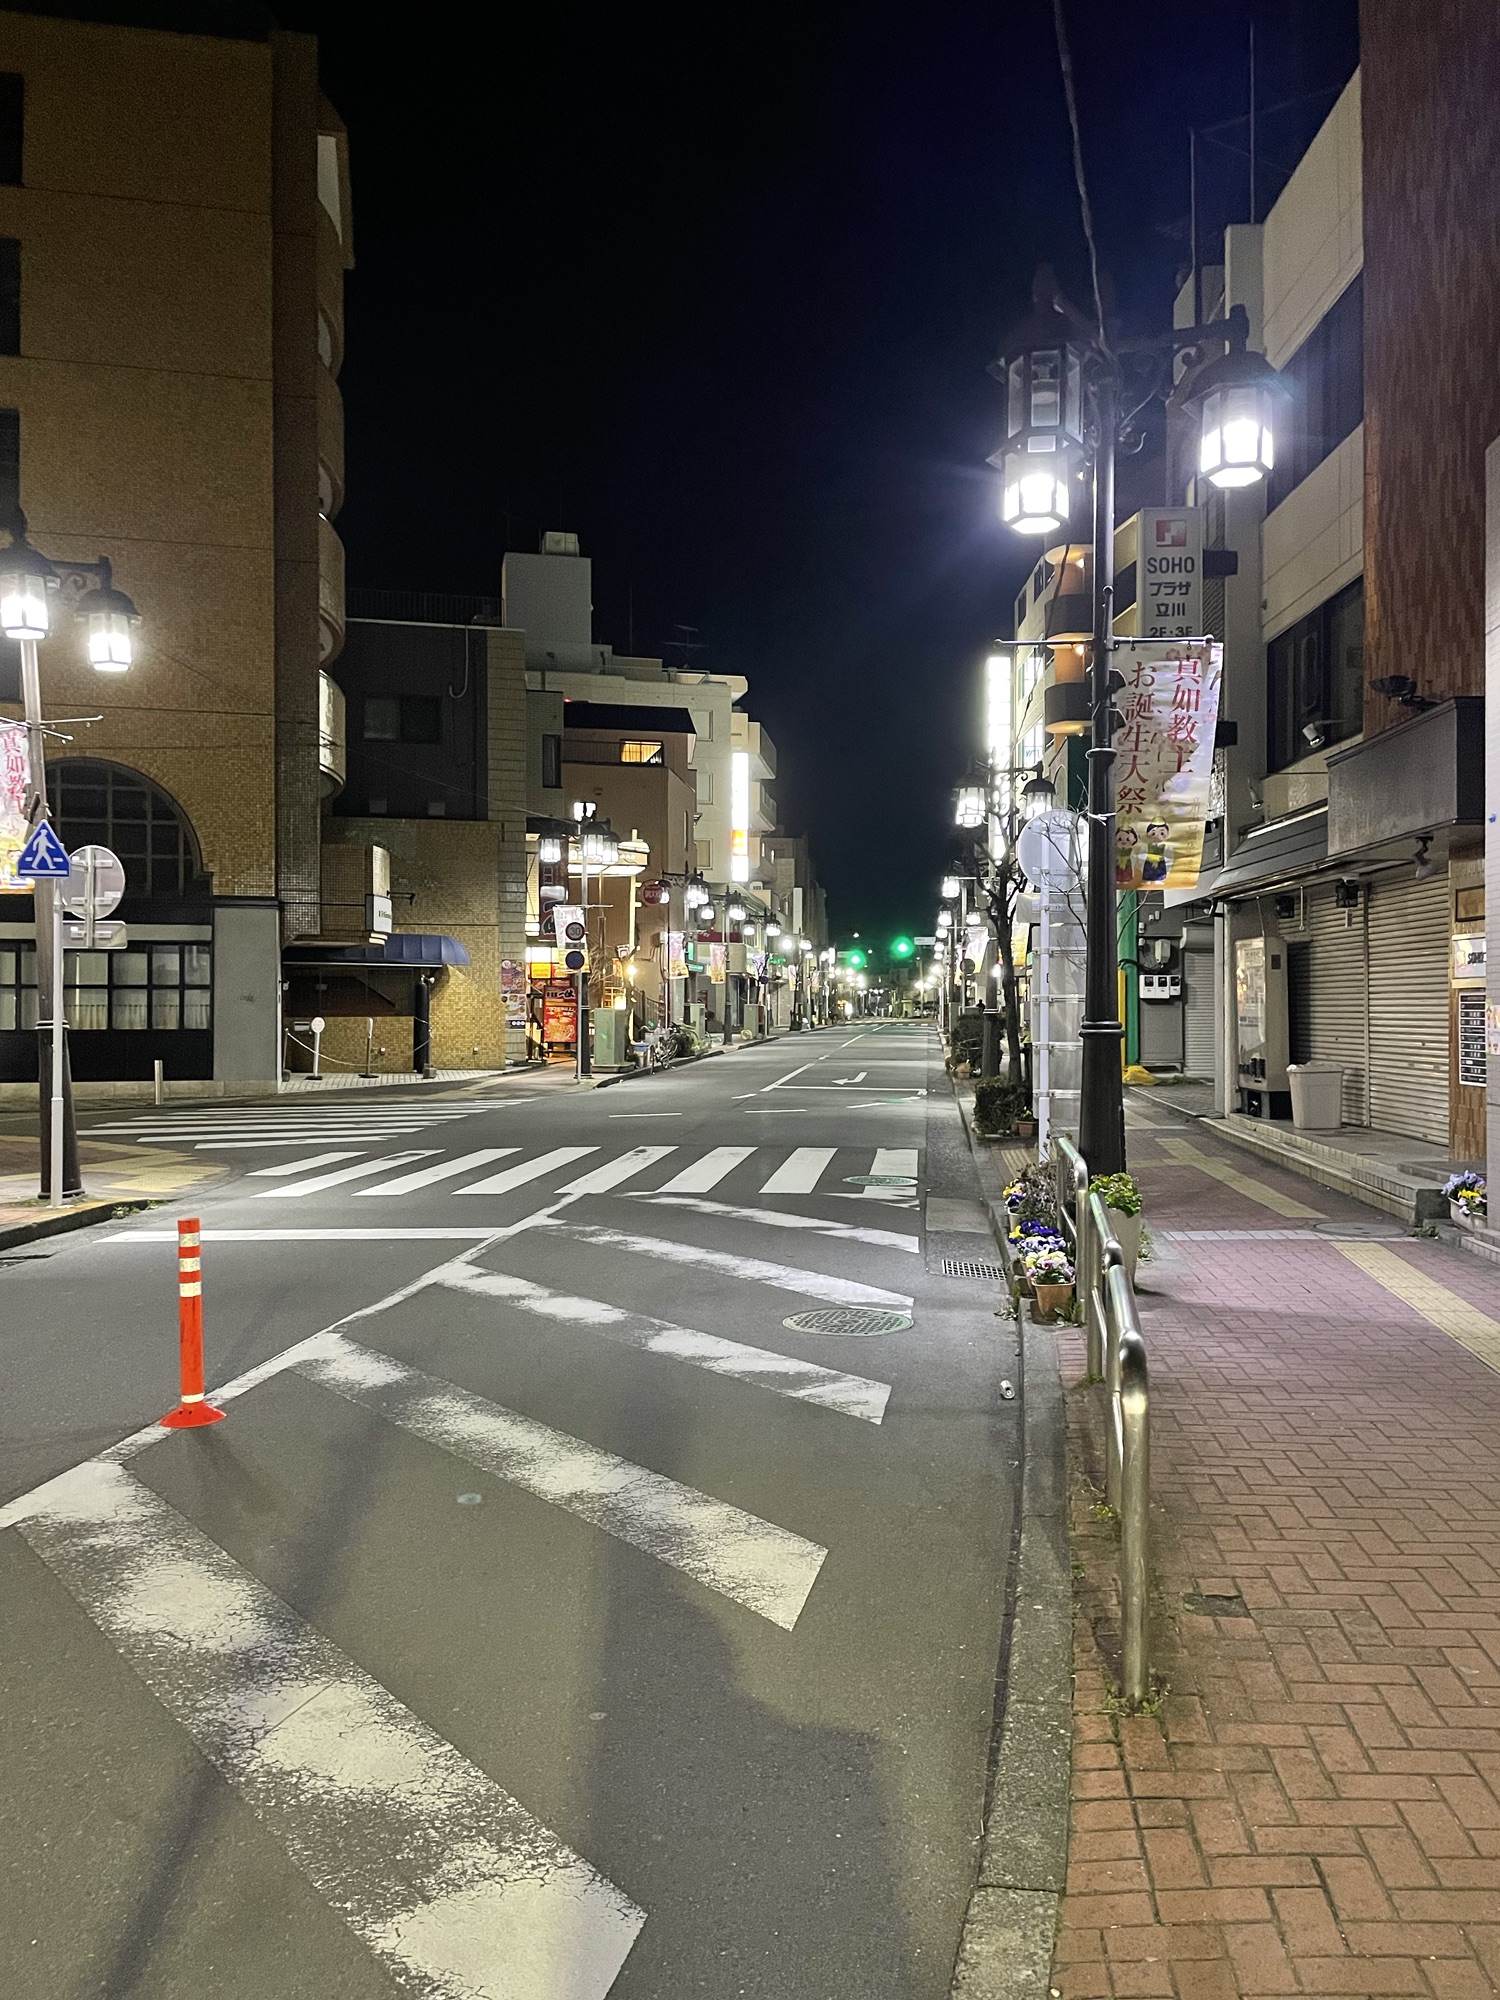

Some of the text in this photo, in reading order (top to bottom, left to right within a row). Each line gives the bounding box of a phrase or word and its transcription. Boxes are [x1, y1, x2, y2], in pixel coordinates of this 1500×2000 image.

[1147, 557, 1195, 574] SOHO
[1156, 602, 1186, 617] 立川
[1164, 654, 1202, 773] 真如教主
[1117, 661, 1157, 815] お誕生大祭
[570, 926, 580, 936] 30
